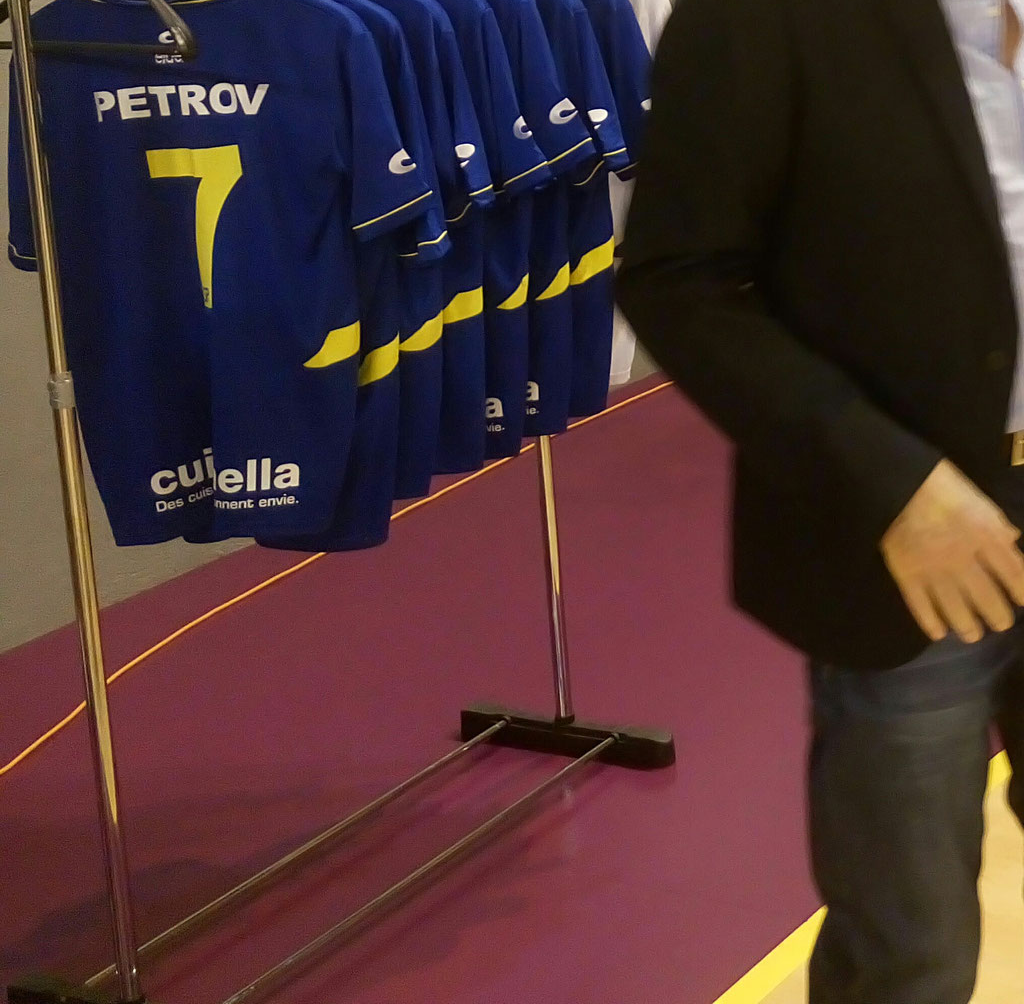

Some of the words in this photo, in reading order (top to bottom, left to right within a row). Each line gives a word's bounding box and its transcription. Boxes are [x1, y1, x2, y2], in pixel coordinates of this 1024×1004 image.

[93, 82, 270, 122] PETROV
[145, 144, 243, 309] 7
[155, 498, 185, 513] Des
[258, 493, 299, 509] envie.
